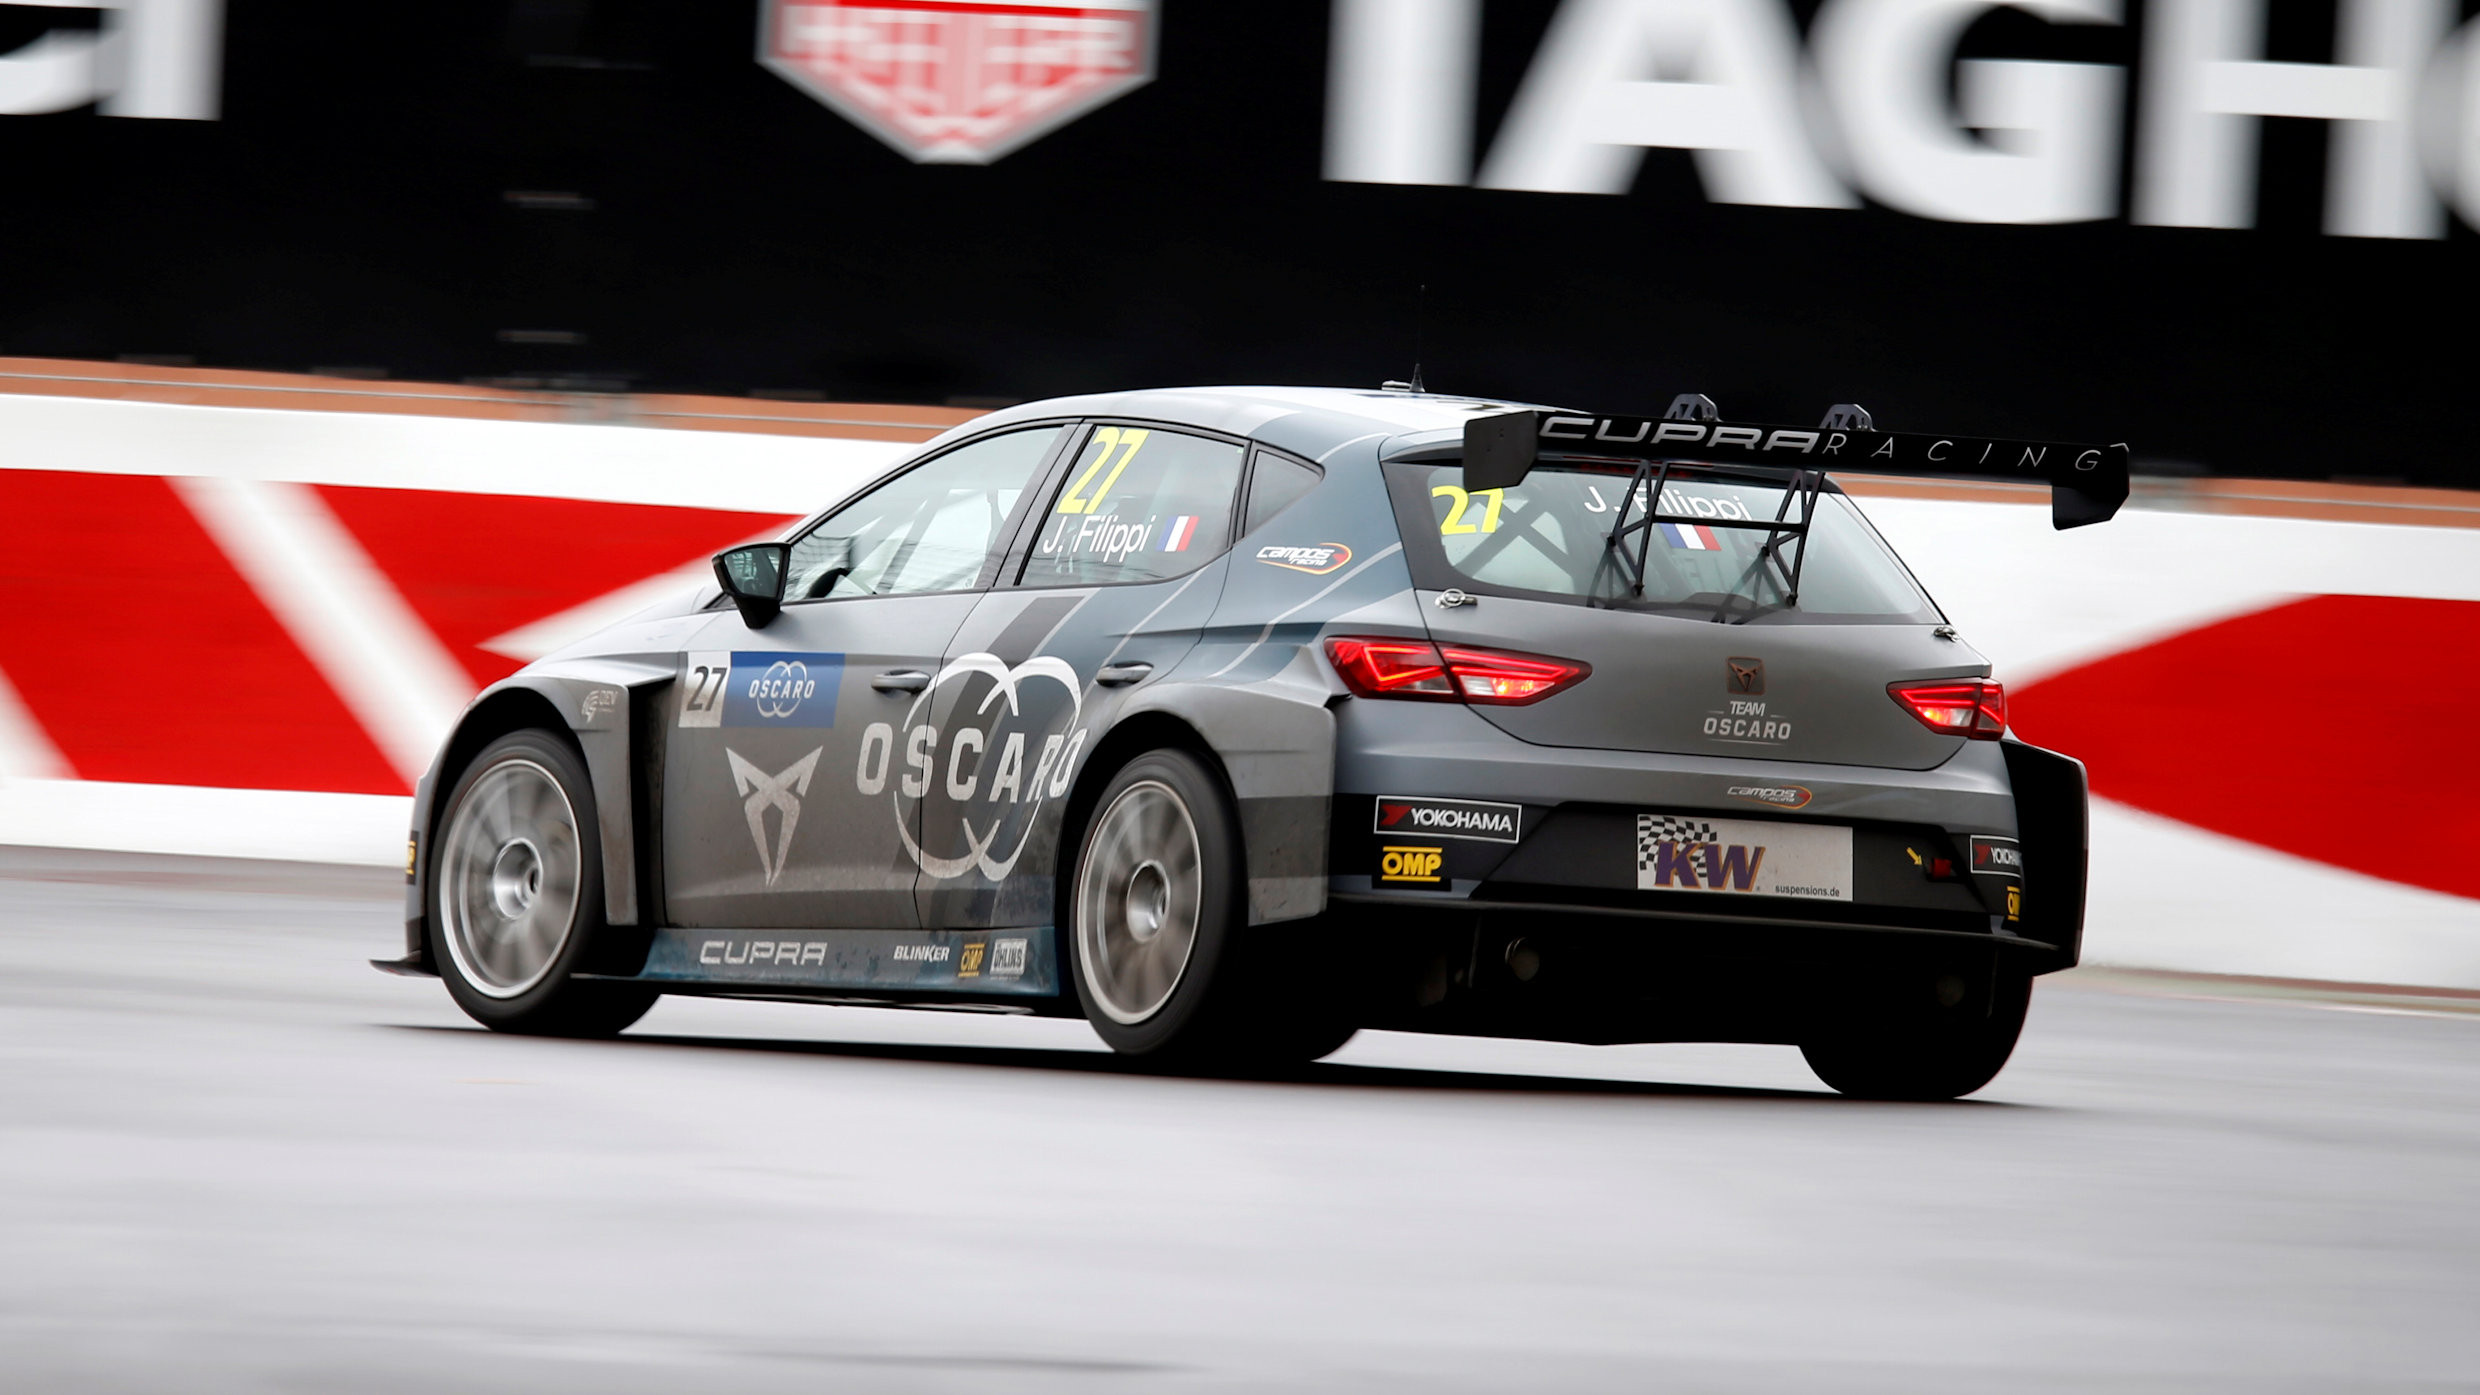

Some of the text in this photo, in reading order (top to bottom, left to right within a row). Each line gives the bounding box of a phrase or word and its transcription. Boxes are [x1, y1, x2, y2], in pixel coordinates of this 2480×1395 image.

[1322, 0, 2480, 240] AGH
[1539, 415, 2102, 471] CUPRA RACING
[1056, 426, 1149, 514] 27
[1431, 485, 1504, 535] 27
[1583, 485, 1622, 513] J.
[1042, 514, 1157, 563] J. Filippi
[686, 665, 728, 712] 27
[747, 679, 816, 699] OSCARO
[1729, 700, 1767, 717] TEAM
[1703, 717, 1792, 740] OSCARO
[856, 722, 1088, 804] OSCARO
[1410, 807, 1513, 833] YOKOHAMA
[1381, 851, 1442, 877] OMP
[1653, 840, 1767, 893] KW
[1775, 884, 1840, 897] suspensions.de
[699, 940, 828, 966] CUPRA
[893, 943, 951, 963] BLINKER
[960, 948, 984, 972] OMP
